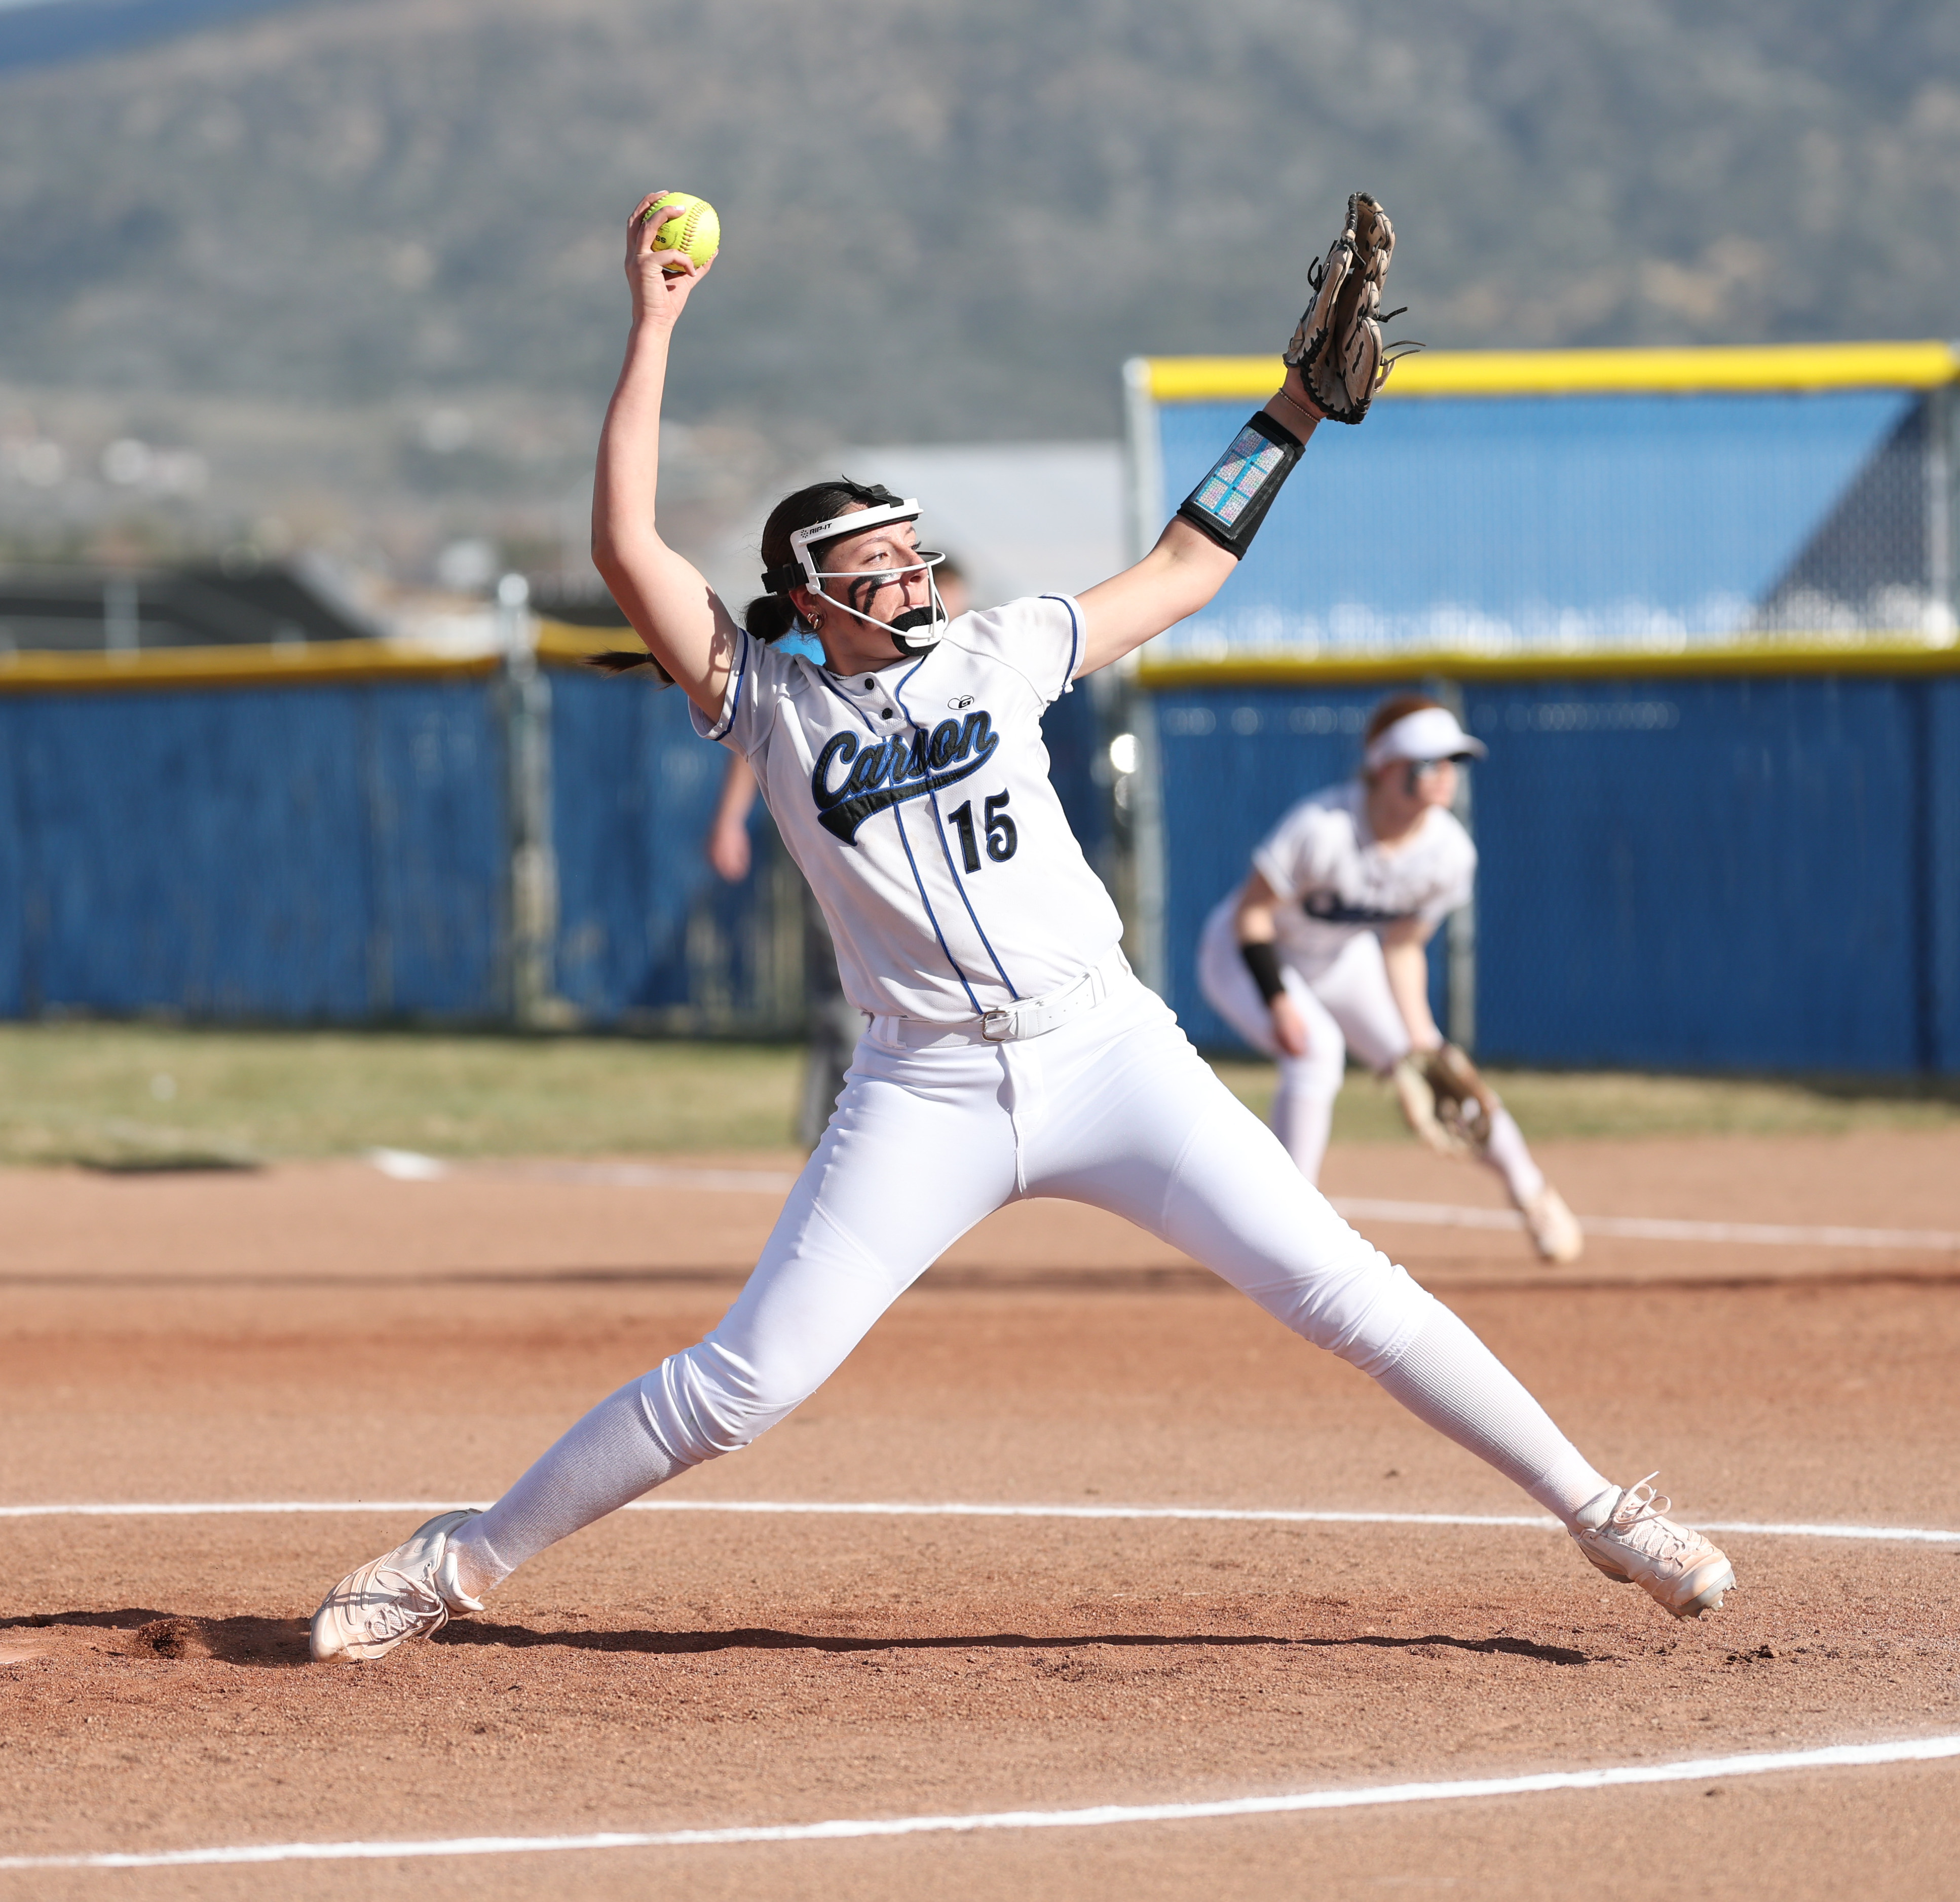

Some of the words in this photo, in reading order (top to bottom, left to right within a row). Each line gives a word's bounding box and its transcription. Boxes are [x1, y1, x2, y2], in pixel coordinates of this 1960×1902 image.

[810, 523, 832, 535] RIP-IT
[811, 710, 1000, 811] Carson
[948, 788, 1017, 875] 15
